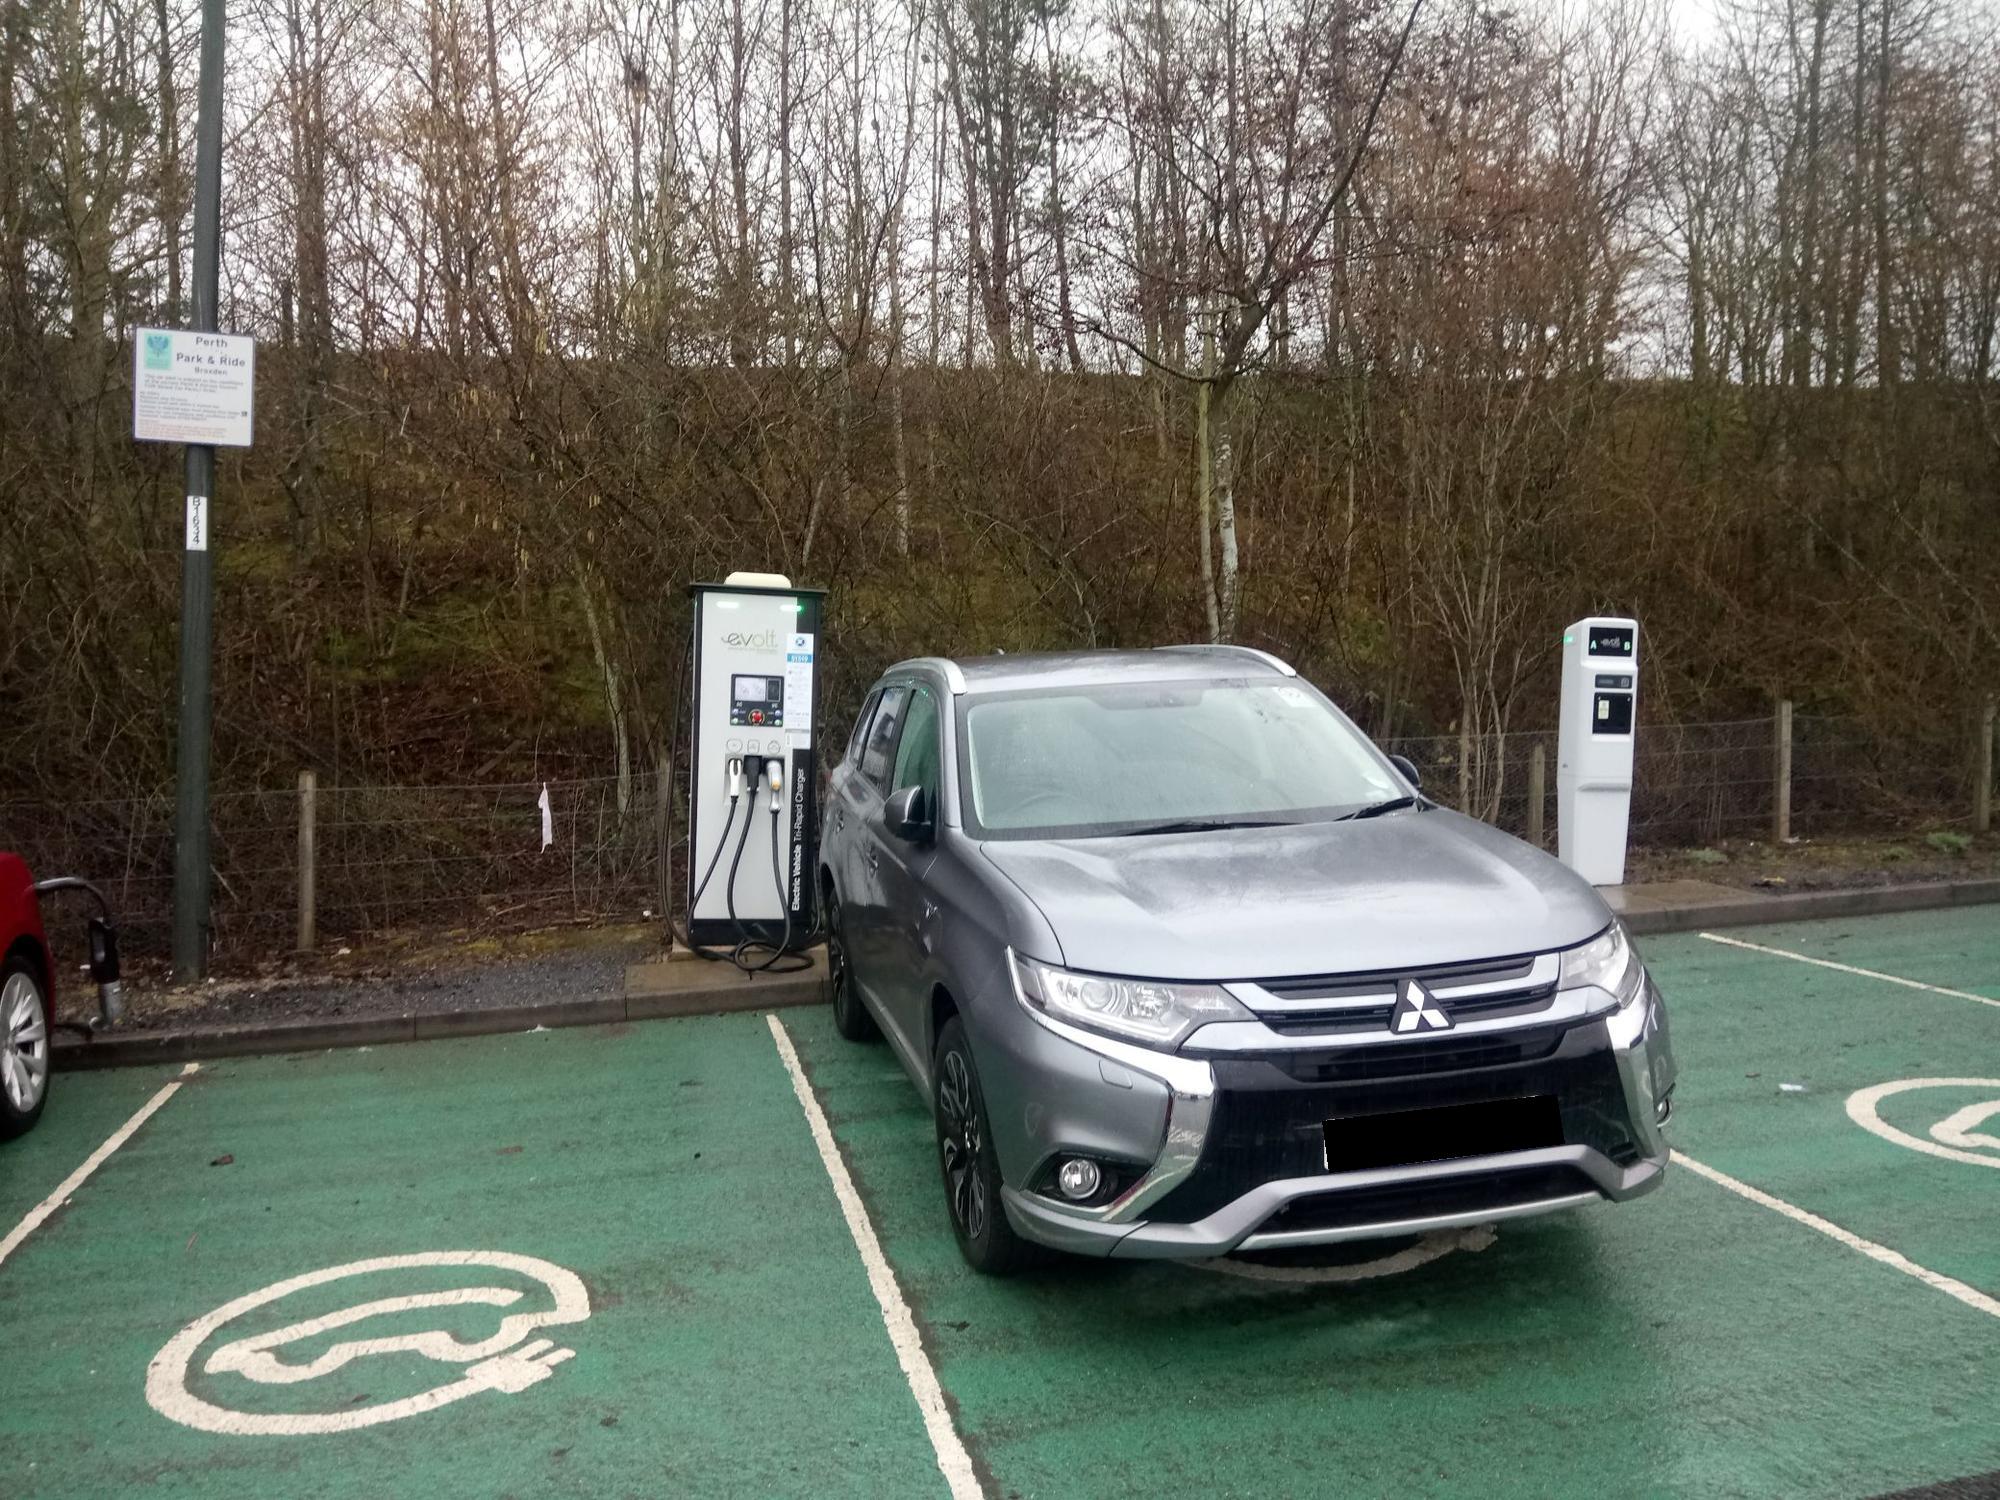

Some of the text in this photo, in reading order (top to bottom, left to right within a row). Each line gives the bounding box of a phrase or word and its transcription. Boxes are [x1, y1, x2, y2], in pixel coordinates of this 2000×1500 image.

[195, 336, 228, 348] Perth
[176, 352, 203, 364] Park
[207, 355, 215, 365] &
[219, 356, 246, 367] Ride
[1590, 640, 1597, 649] A
[1624, 641, 1631, 650] B
[792, 844, 802, 877] Vehicle
[791, 877, 801, 912] Electric
